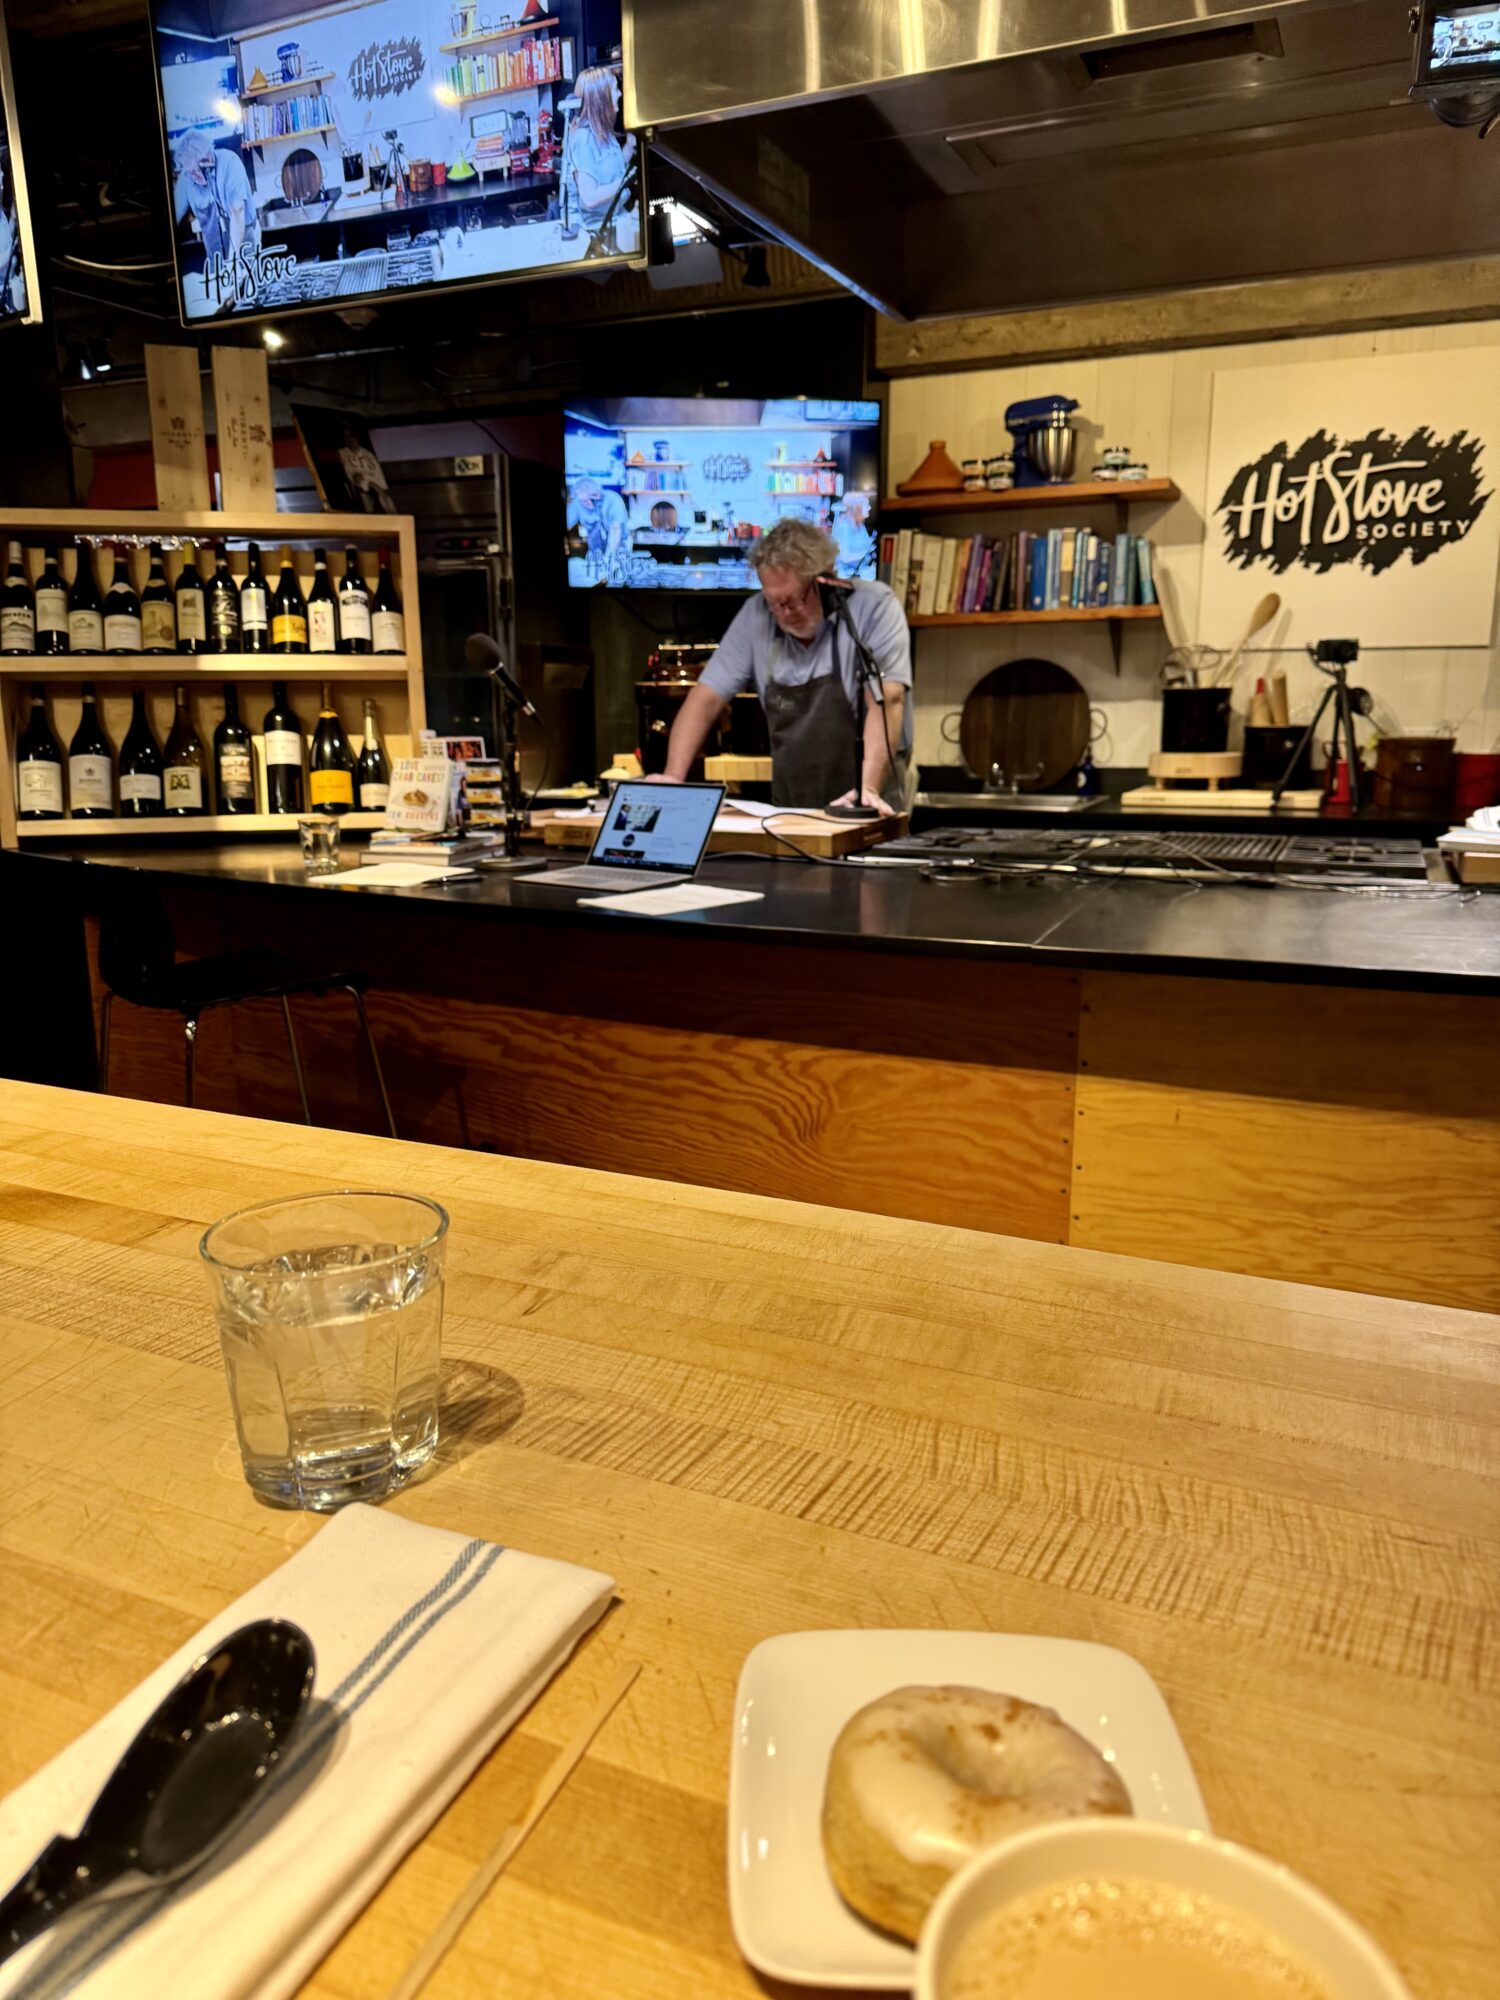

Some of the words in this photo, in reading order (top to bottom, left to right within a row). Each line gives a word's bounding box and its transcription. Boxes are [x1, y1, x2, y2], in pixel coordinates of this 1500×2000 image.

[351, 54, 378, 94] Hot
[376, 48, 415, 88] Stove
[1227, 461, 1323, 550] Hot
[1321, 450, 1447, 545] Stove
[1355, 519, 1471, 541] SOCIETY
